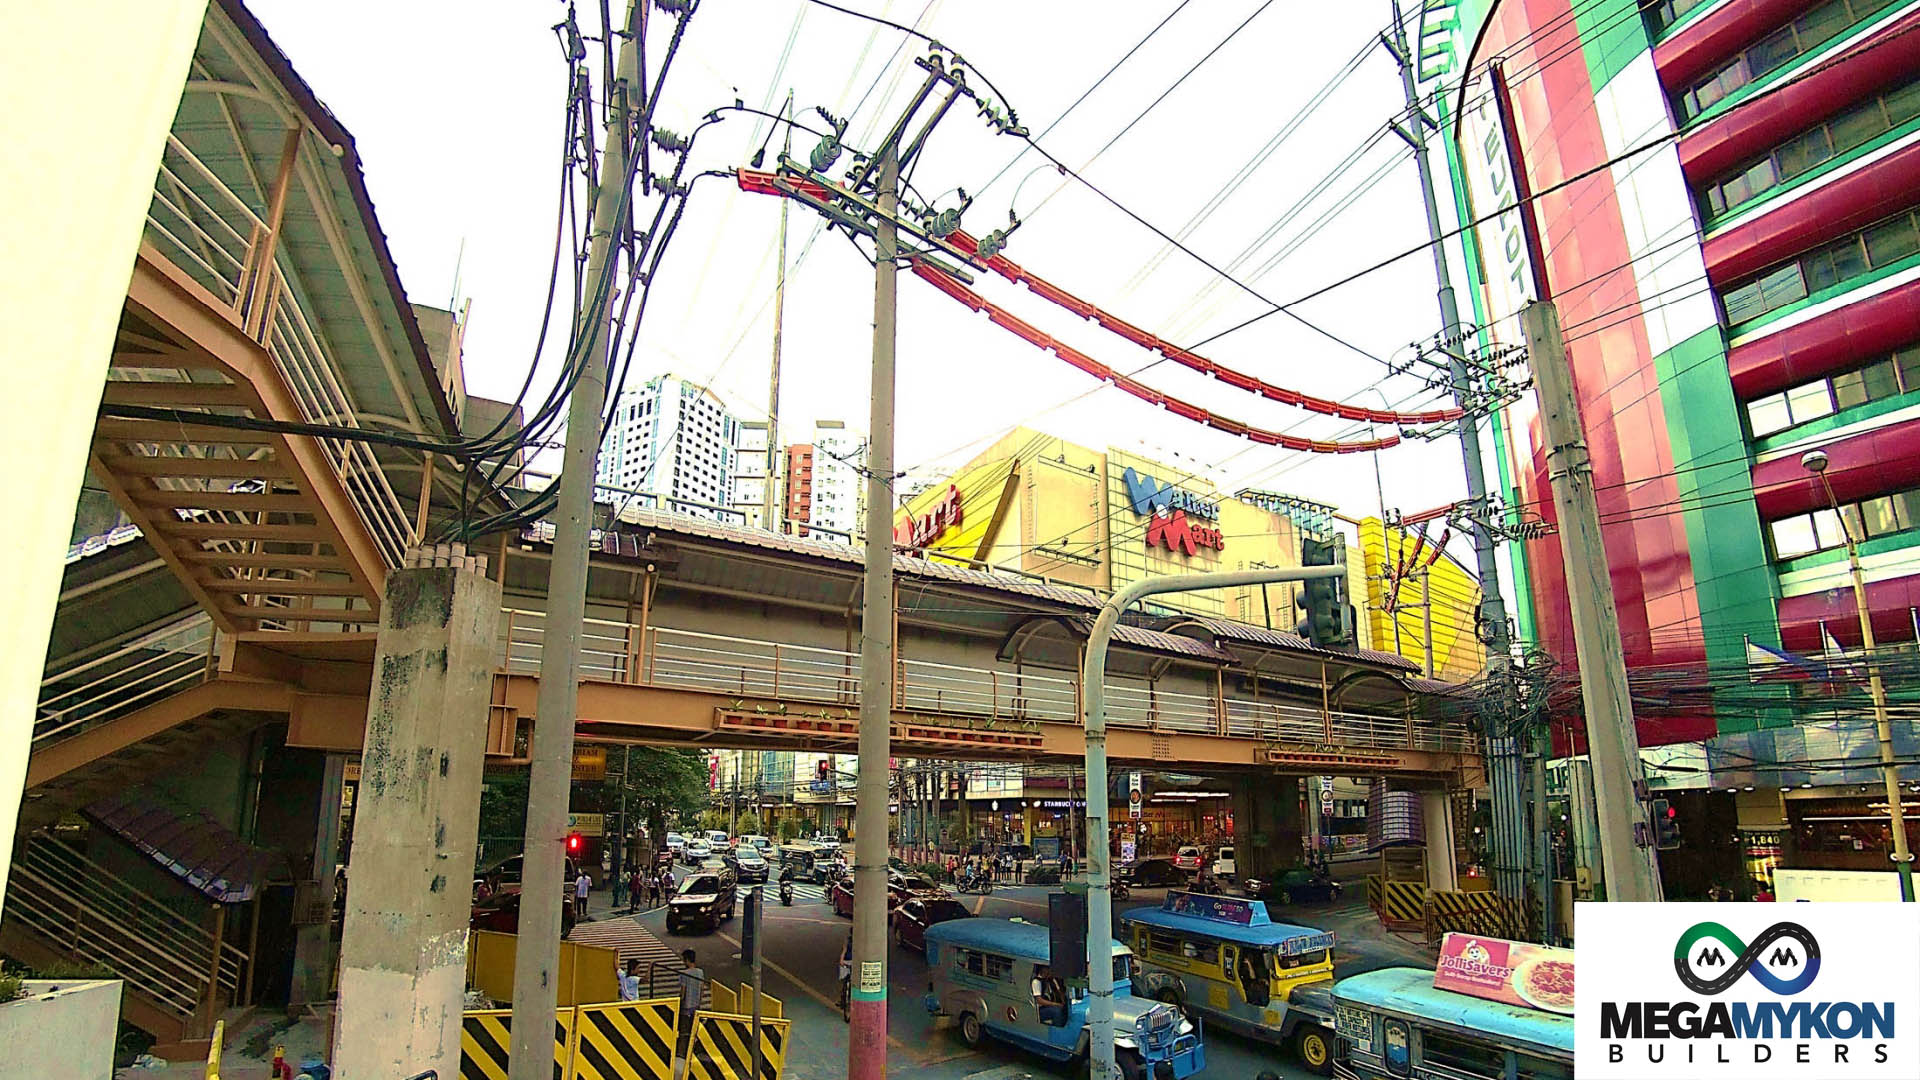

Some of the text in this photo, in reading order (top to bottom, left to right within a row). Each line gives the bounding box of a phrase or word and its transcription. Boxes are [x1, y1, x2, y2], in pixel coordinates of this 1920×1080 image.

[1123, 466, 1220, 522] Walter
[1146, 509, 1225, 557] Mart
[1044, 800, 1075, 808] STARBUC
[1440, 955, 1510, 978] JolliSavers
